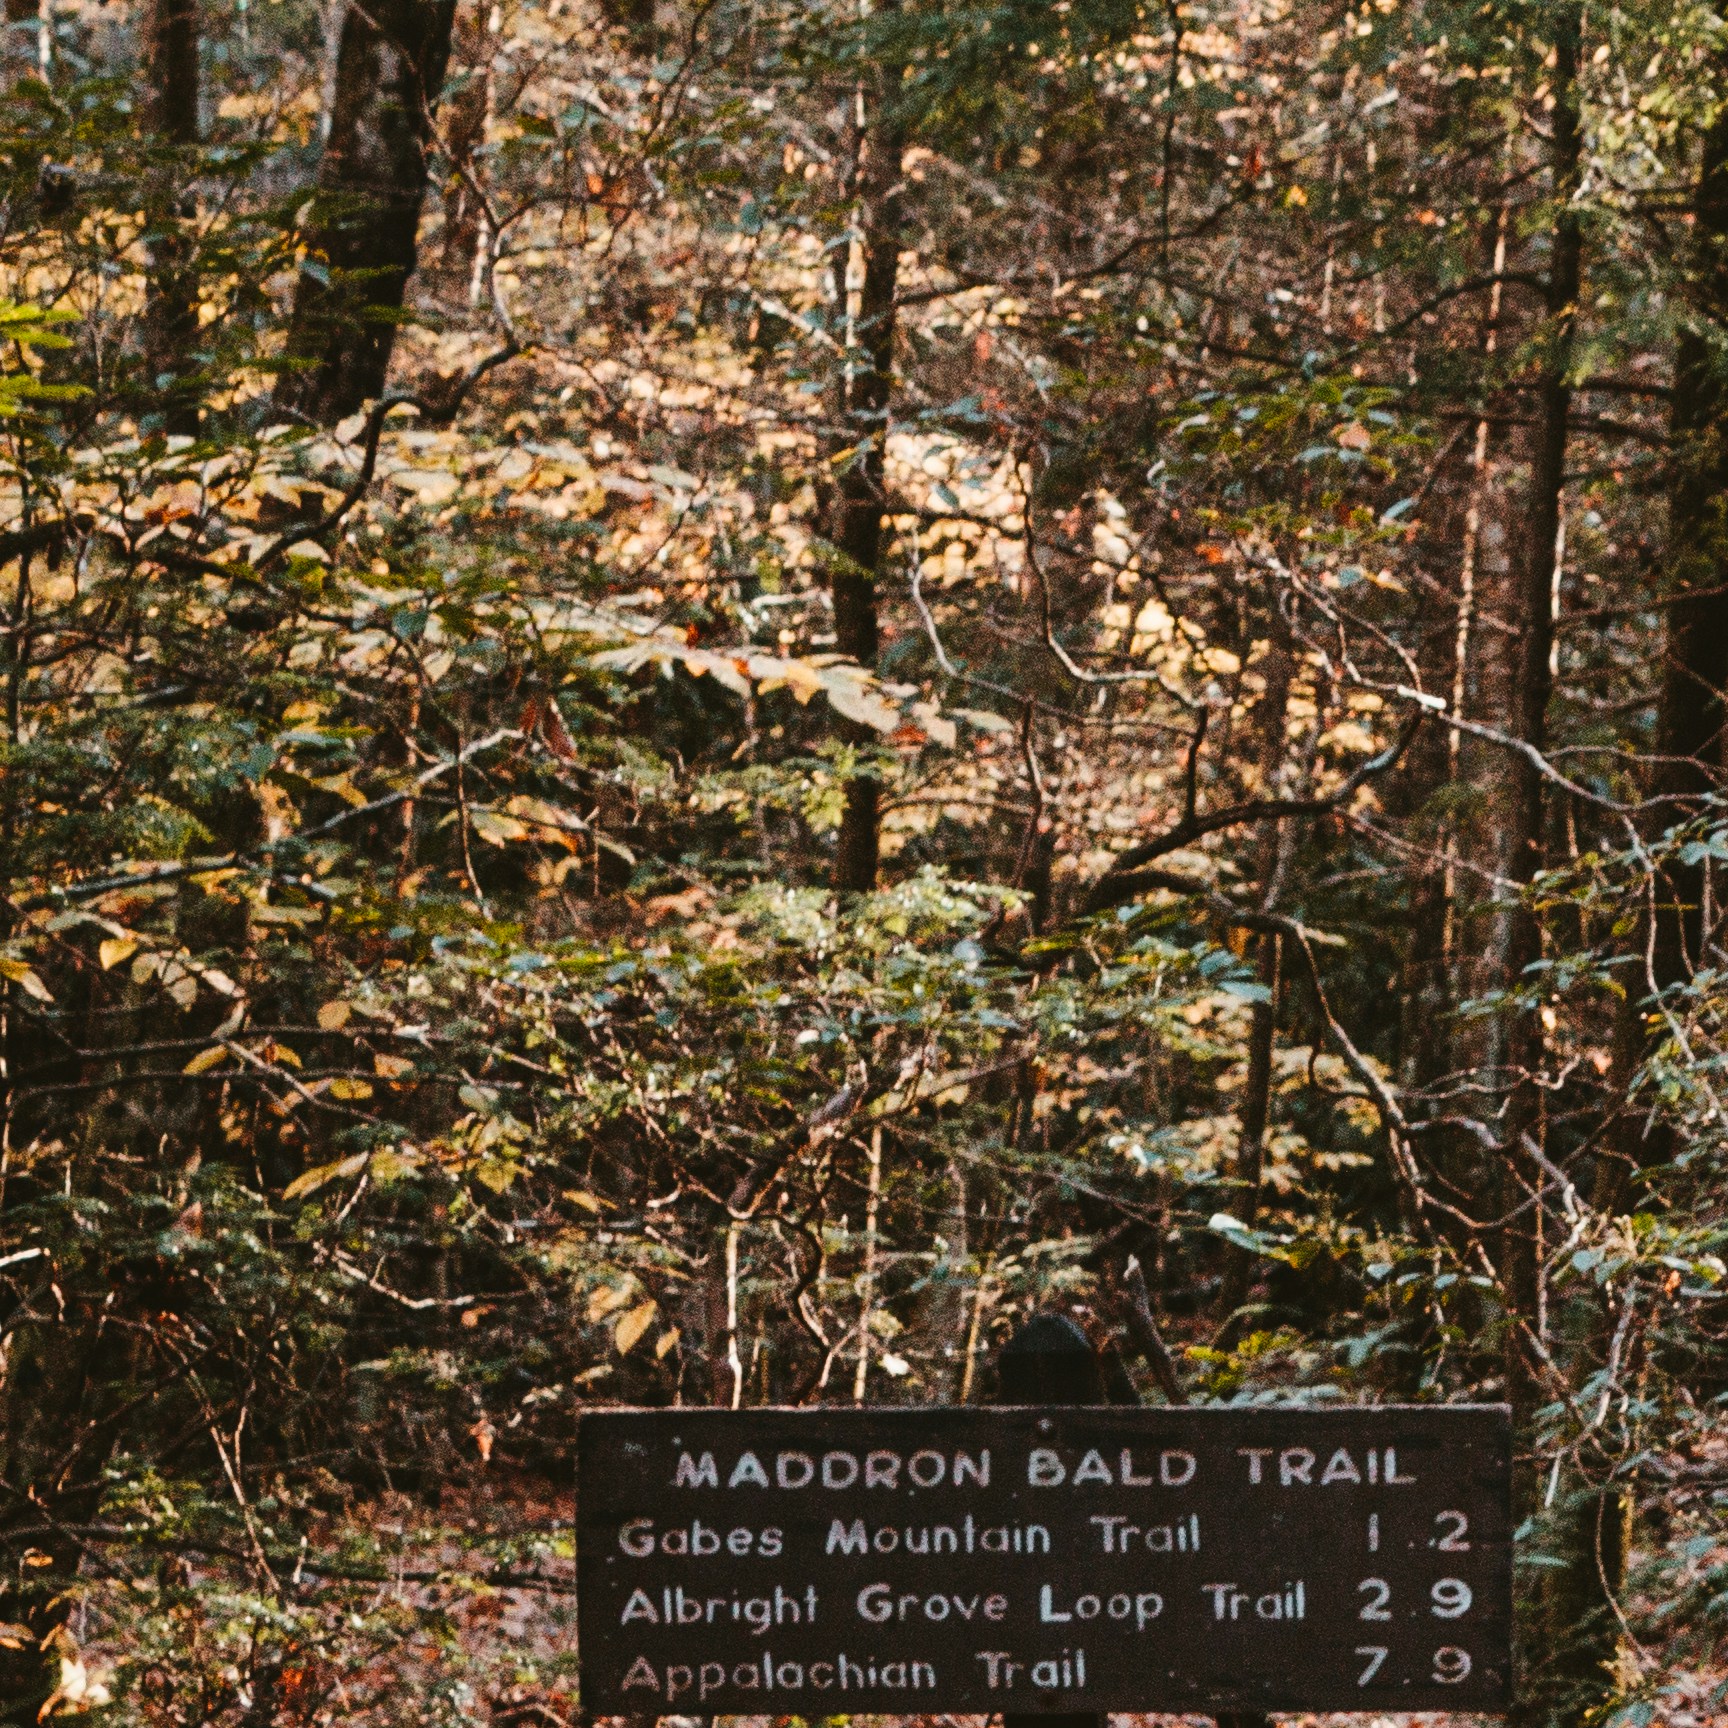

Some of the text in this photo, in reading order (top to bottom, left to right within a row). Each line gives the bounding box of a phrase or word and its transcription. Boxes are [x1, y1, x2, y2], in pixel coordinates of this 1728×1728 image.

[674, 1449, 1416, 1488] MADDRON BALD TRAIL
[620, 1521, 782, 1556] Gabes
[826, 1516, 1050, 1554] Mountain
[1091, 1515, 1199, 1552] Trail
[622, 1587, 816, 1633] Albright
[858, 1584, 1006, 1621] Grove
[1041, 1585, 1162, 1628] Loop
[1204, 1581, 1305, 1619] Trail
[620, 1653, 935, 1697] Appalachian
[979, 1650, 1085, 1686] Trail
